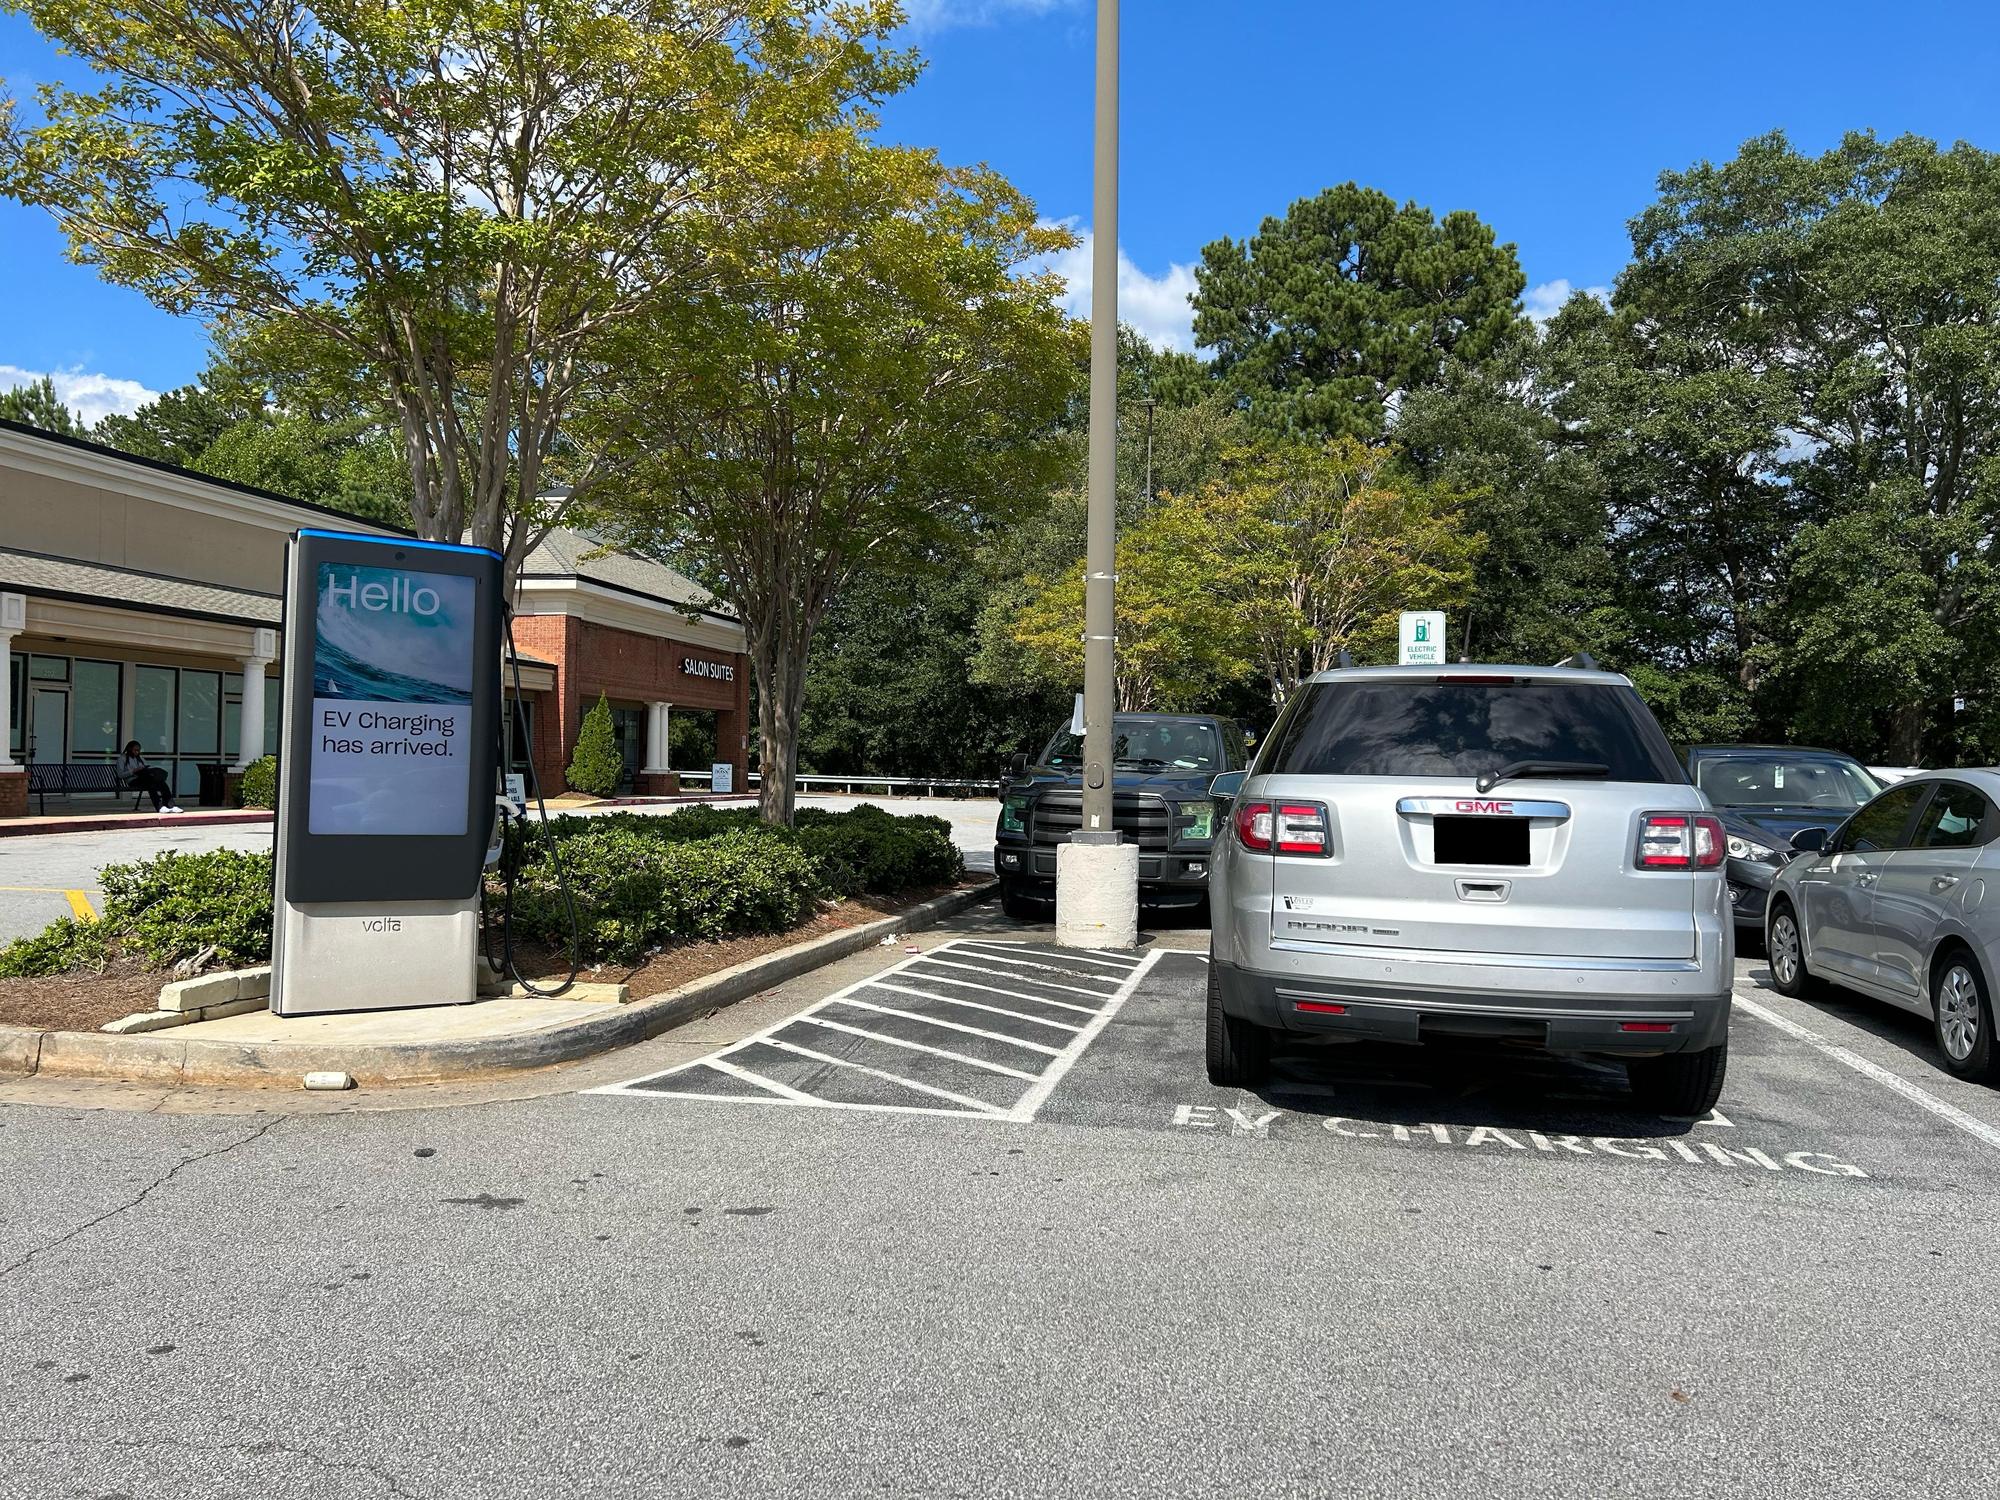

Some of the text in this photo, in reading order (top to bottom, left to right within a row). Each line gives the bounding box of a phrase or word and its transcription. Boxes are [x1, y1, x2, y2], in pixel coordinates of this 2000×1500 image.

[327, 573, 441, 616] Hello
[684, 658, 734, 681] SALON SUITES
[323, 710, 455, 737] EV Charging
[322, 735, 454, 757] has arrived.
[1456, 801, 1514, 814] GMC
[362, 917, 401, 932] volta
[1173, 1103, 1872, 1178] EV CHARGING
